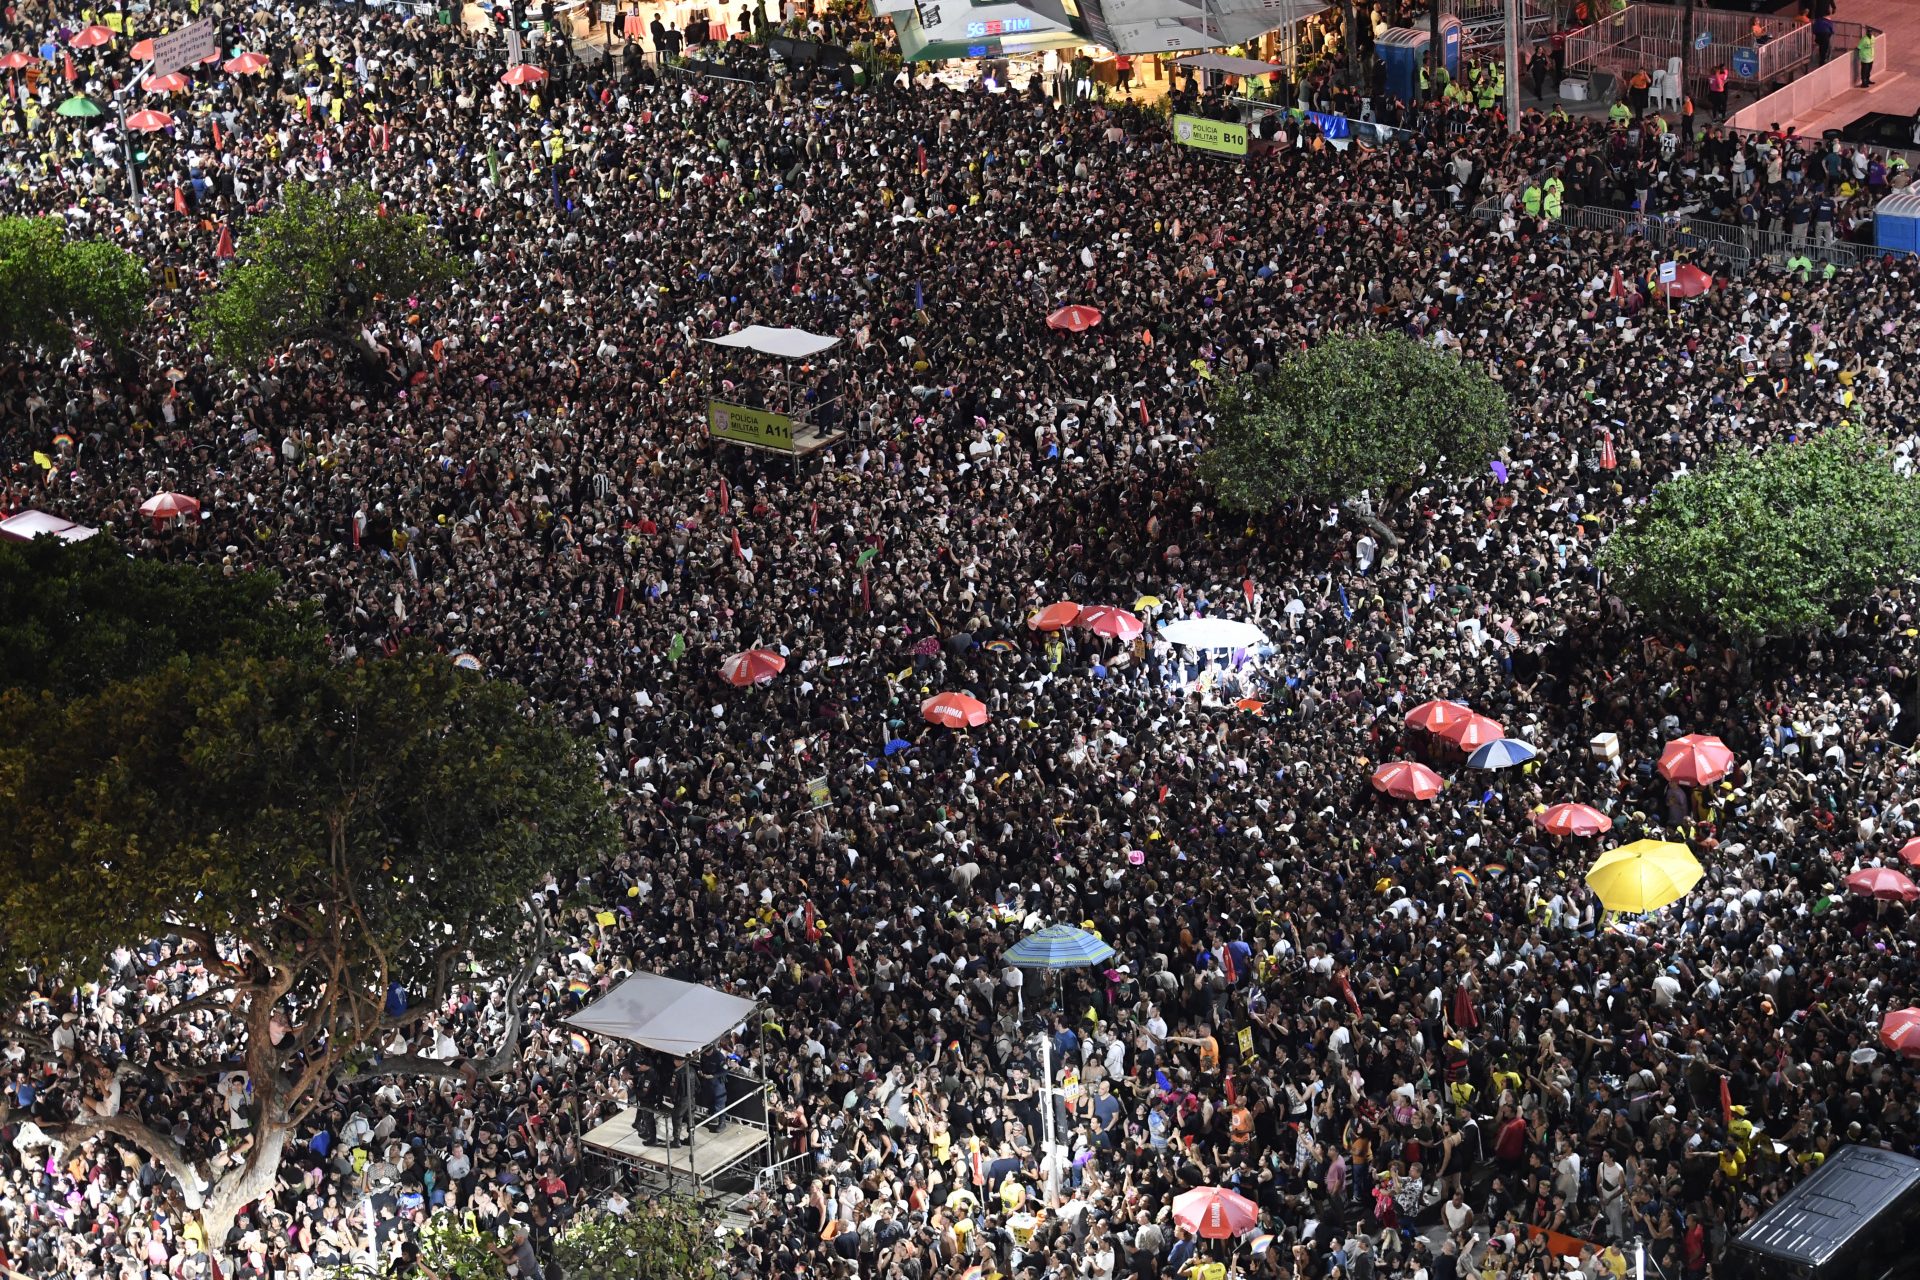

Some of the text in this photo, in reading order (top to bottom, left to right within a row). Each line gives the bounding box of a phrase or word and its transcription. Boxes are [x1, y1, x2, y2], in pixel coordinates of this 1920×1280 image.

[966, 18, 1030, 38] 5G TIM
[1193, 124, 1218, 134] POLÍCIA
[1193, 132, 1244, 145] MILITAR B10
[731, 422, 789, 438] MILITAR A11
[933, 705, 963, 719] BRAHMA
[1211, 1203, 1220, 1227] BRAHMA
